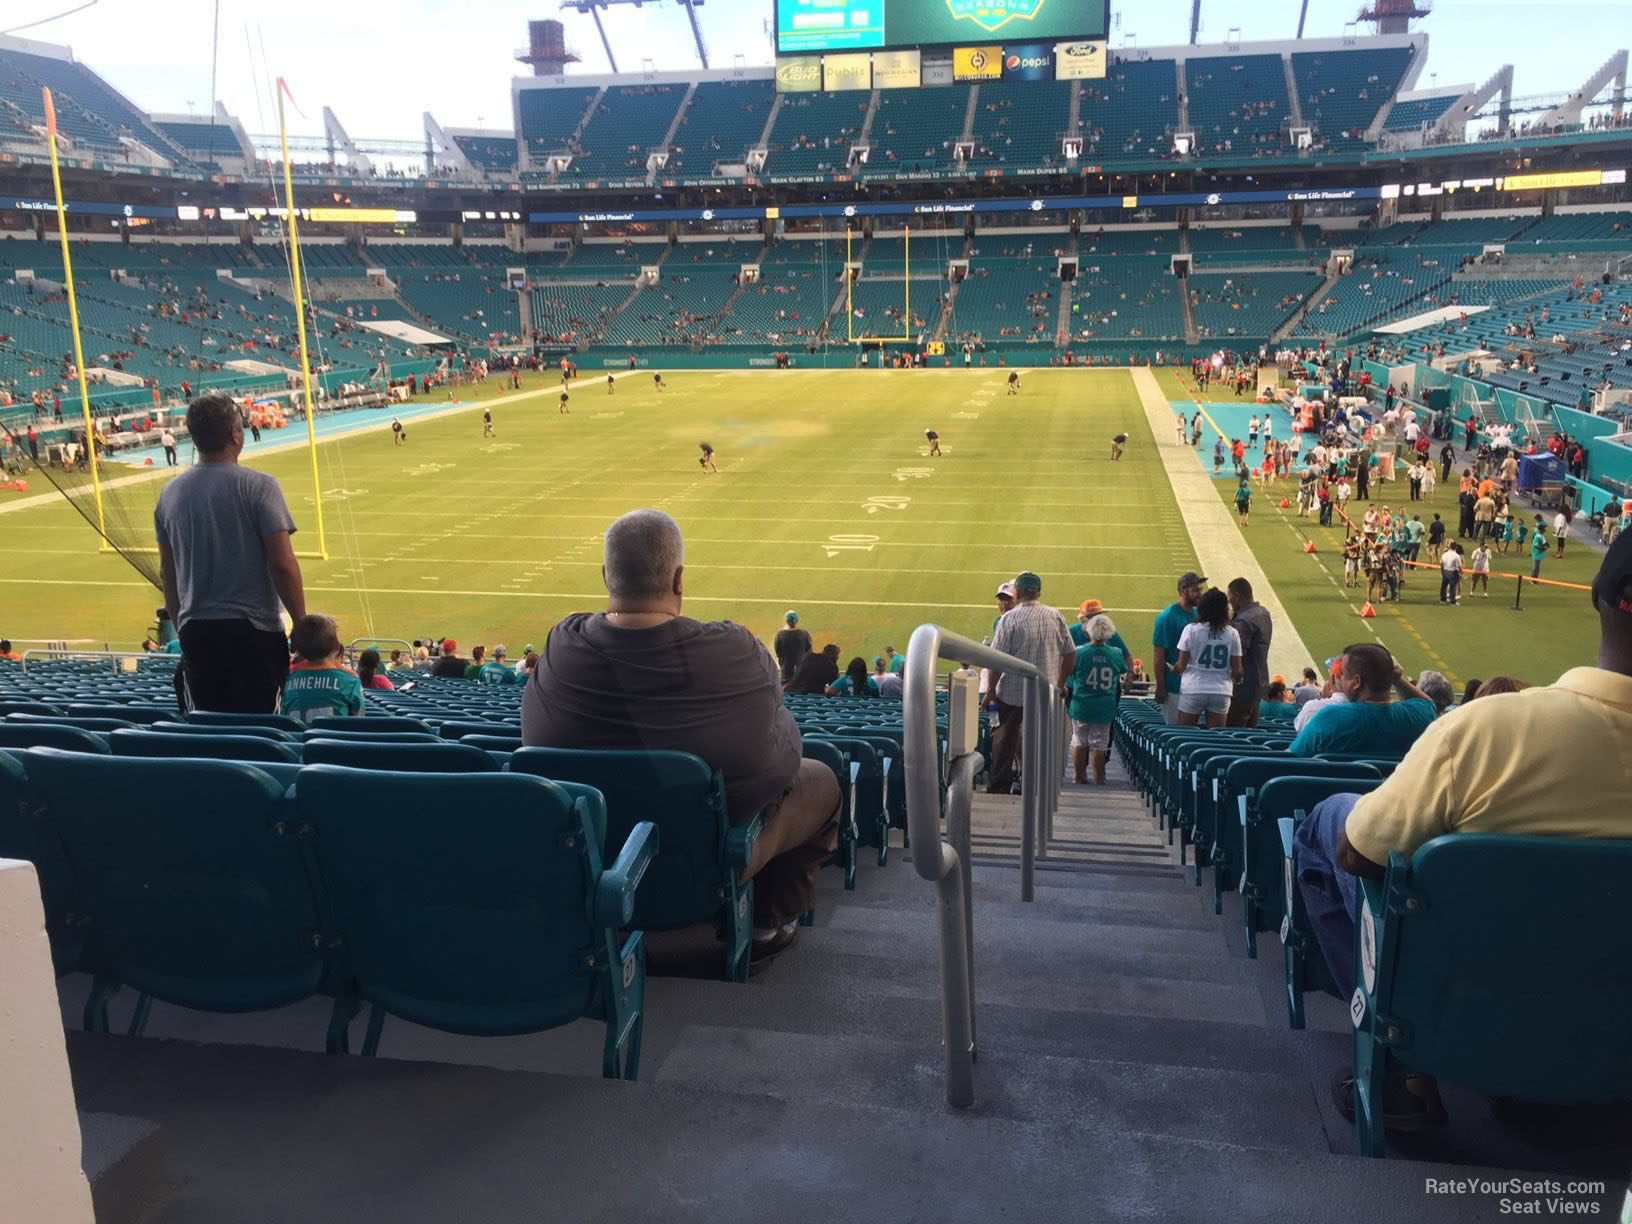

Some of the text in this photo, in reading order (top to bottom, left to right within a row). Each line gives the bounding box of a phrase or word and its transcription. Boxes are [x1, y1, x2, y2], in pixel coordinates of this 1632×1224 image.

[826, 66, 865, 77] Publix
[1021, 56, 1050, 69] pepsi
[821, 534, 880, 553] 10
[1197, 644, 1229, 670] 49
[285, 676, 340, 691] ANNEHILL
[1085, 666, 1114, 690] 49
[1352, 995, 1364, 1018] 27
